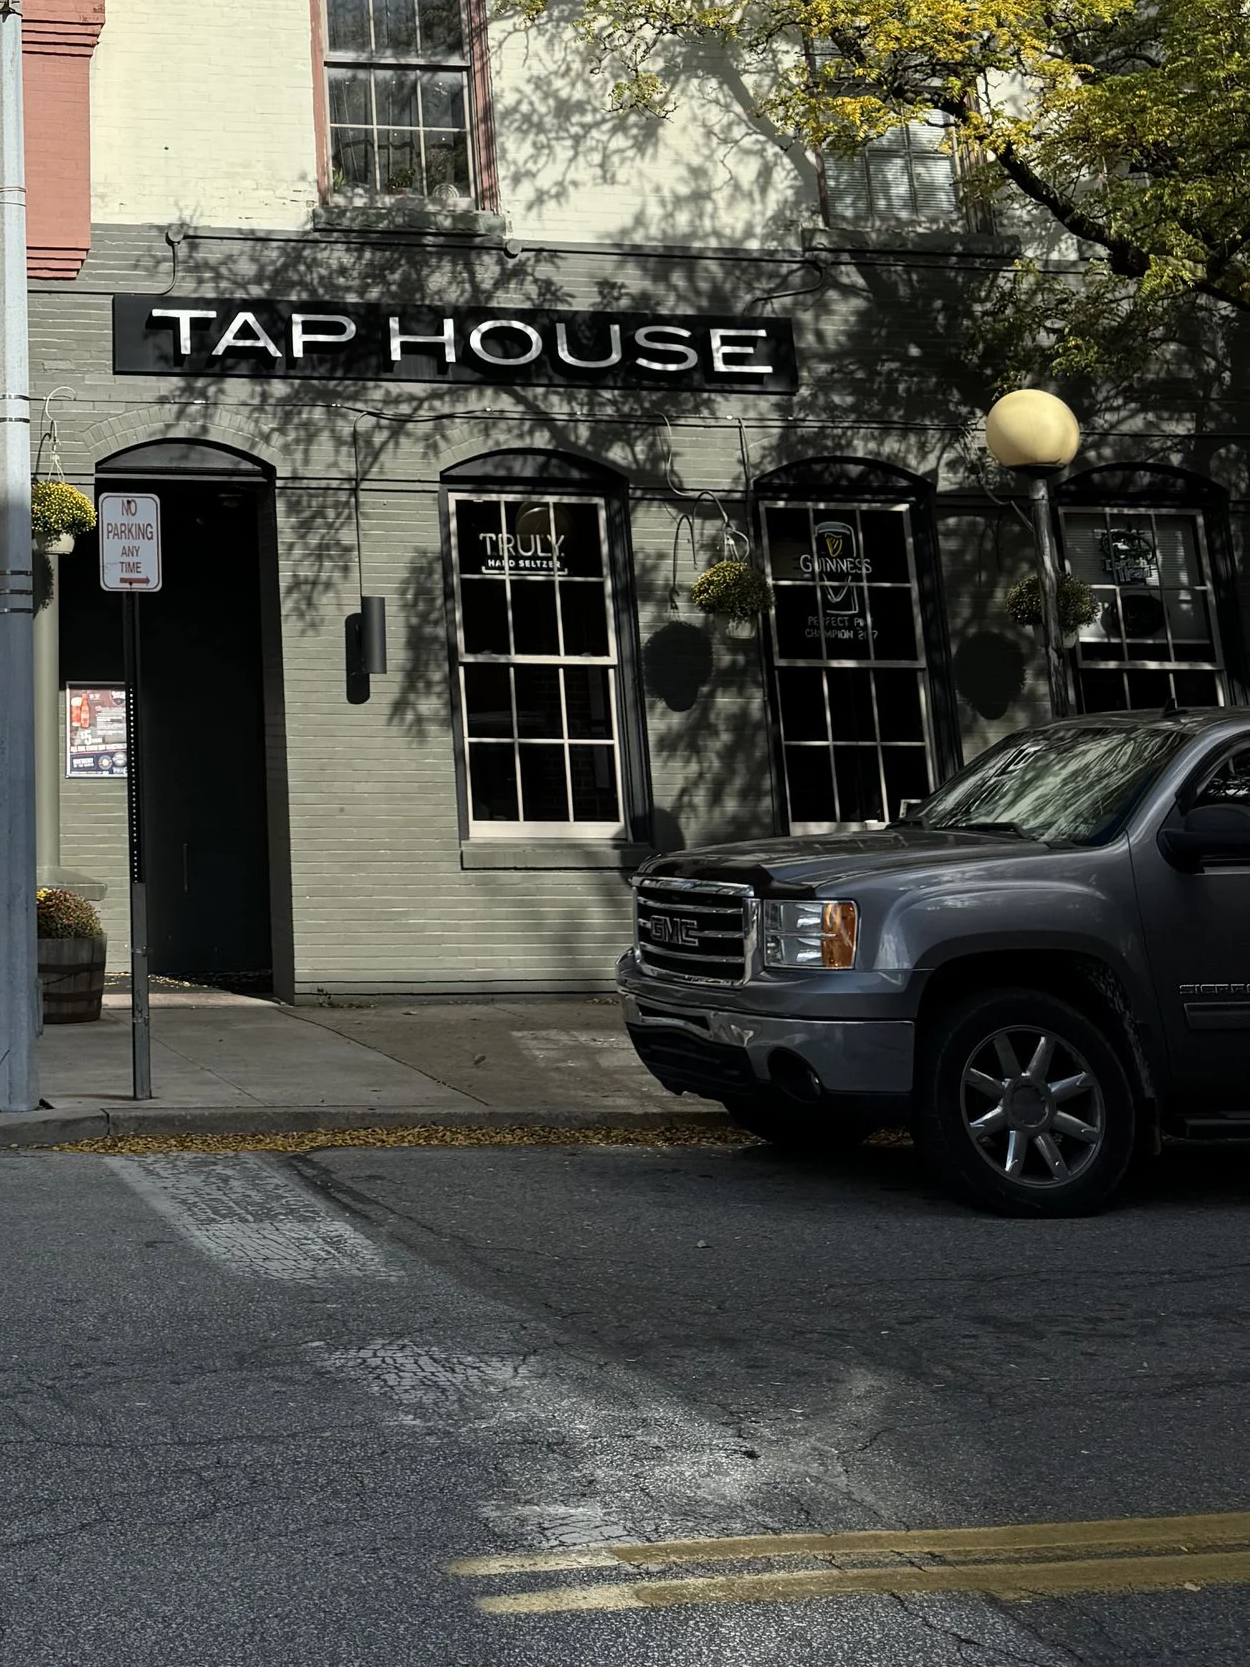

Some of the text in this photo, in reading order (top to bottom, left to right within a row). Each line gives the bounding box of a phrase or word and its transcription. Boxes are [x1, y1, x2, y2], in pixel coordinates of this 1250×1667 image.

[150, 308, 774, 374] TAP HOUSE
[121, 499, 138, 516] NO
[106, 523, 154, 540] PARKING
[121, 546, 140, 557] ANY
[119, 562, 142, 573] TIME
[488, 559, 516, 567] HAD
[800, 554, 872, 574] GUINNESS
[650, 915, 699, 946] GMC
